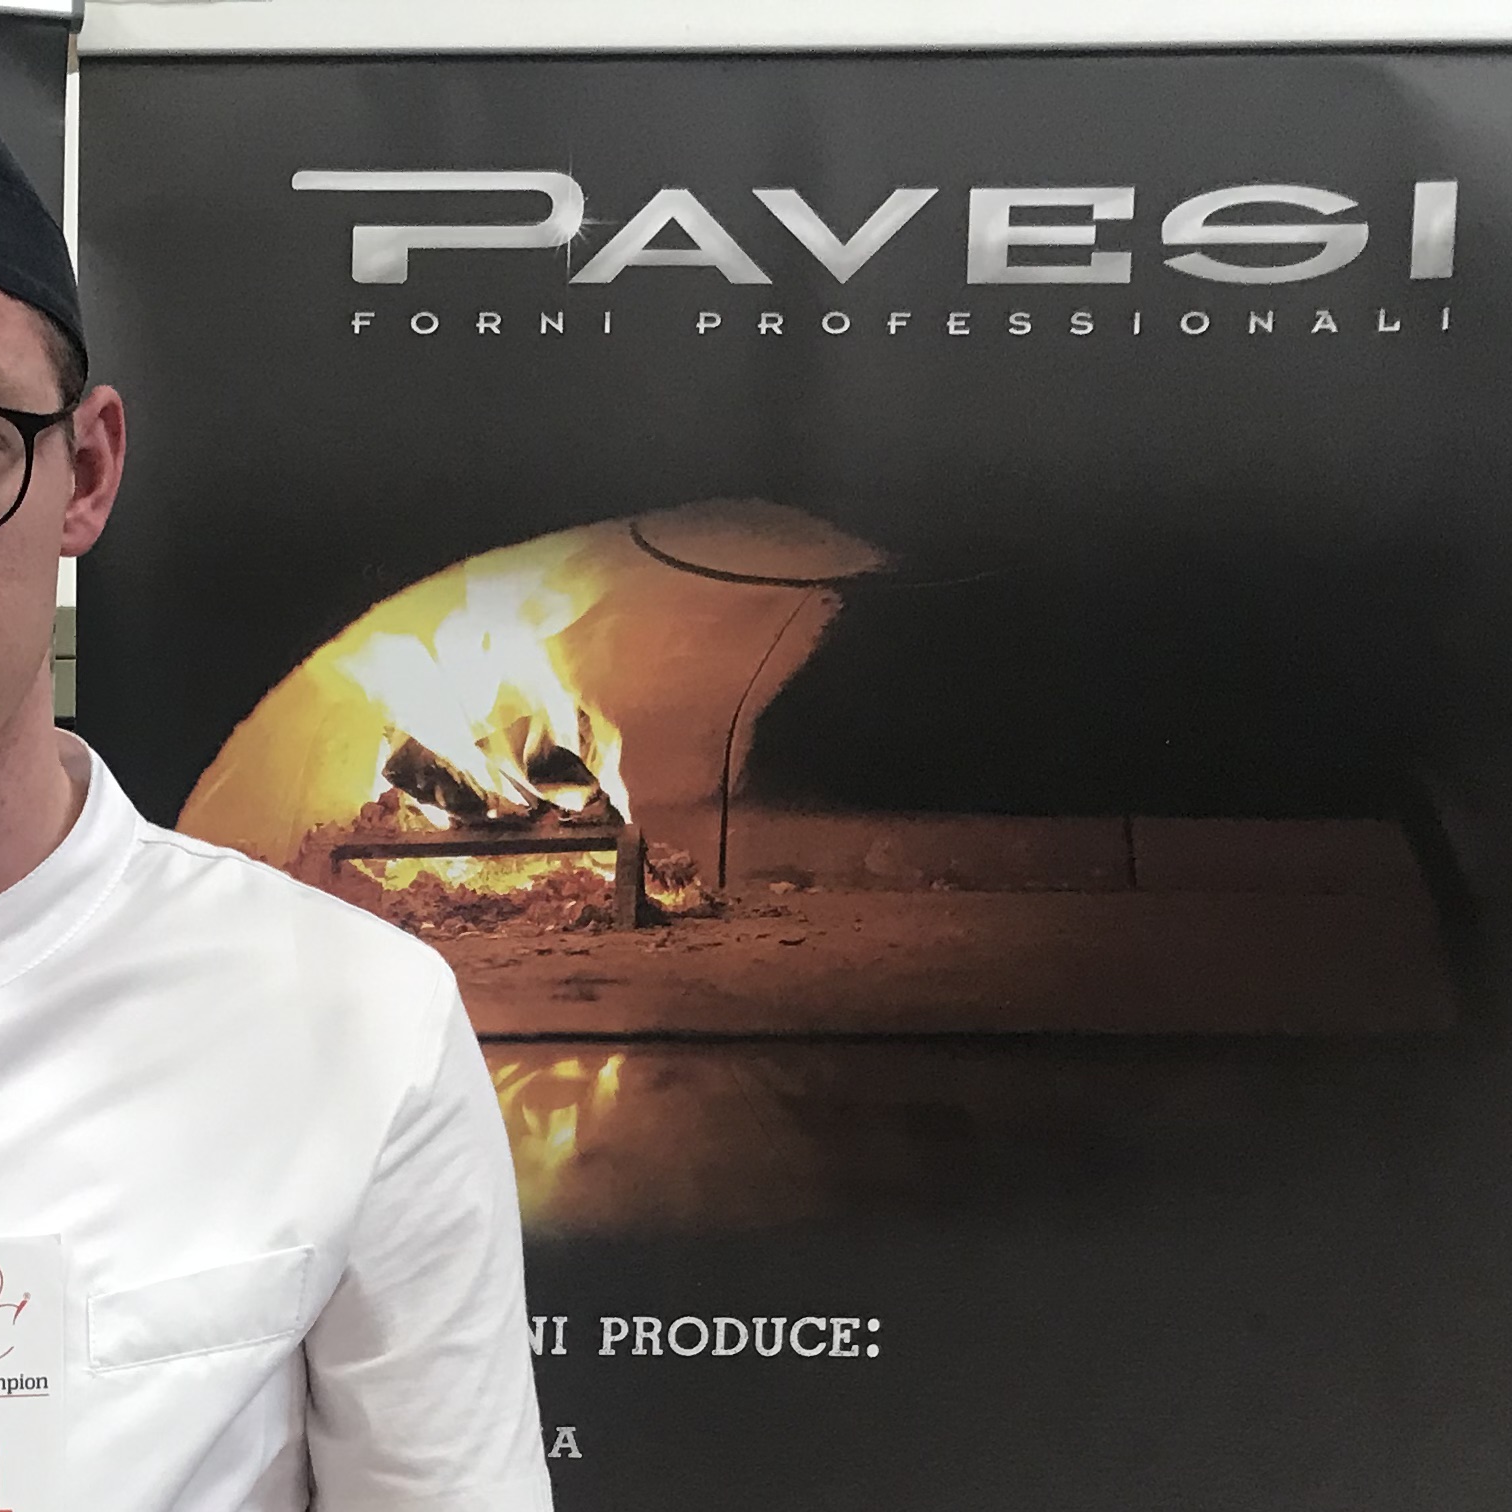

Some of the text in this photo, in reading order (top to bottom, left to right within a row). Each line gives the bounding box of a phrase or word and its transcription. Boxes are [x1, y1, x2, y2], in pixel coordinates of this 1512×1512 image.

[292, 170, 1458, 285] PAVESI
[352, 306, 1452, 337] FORNI PROFESSIONALI
[598, 1315, 880, 1358] PRODUCE:
